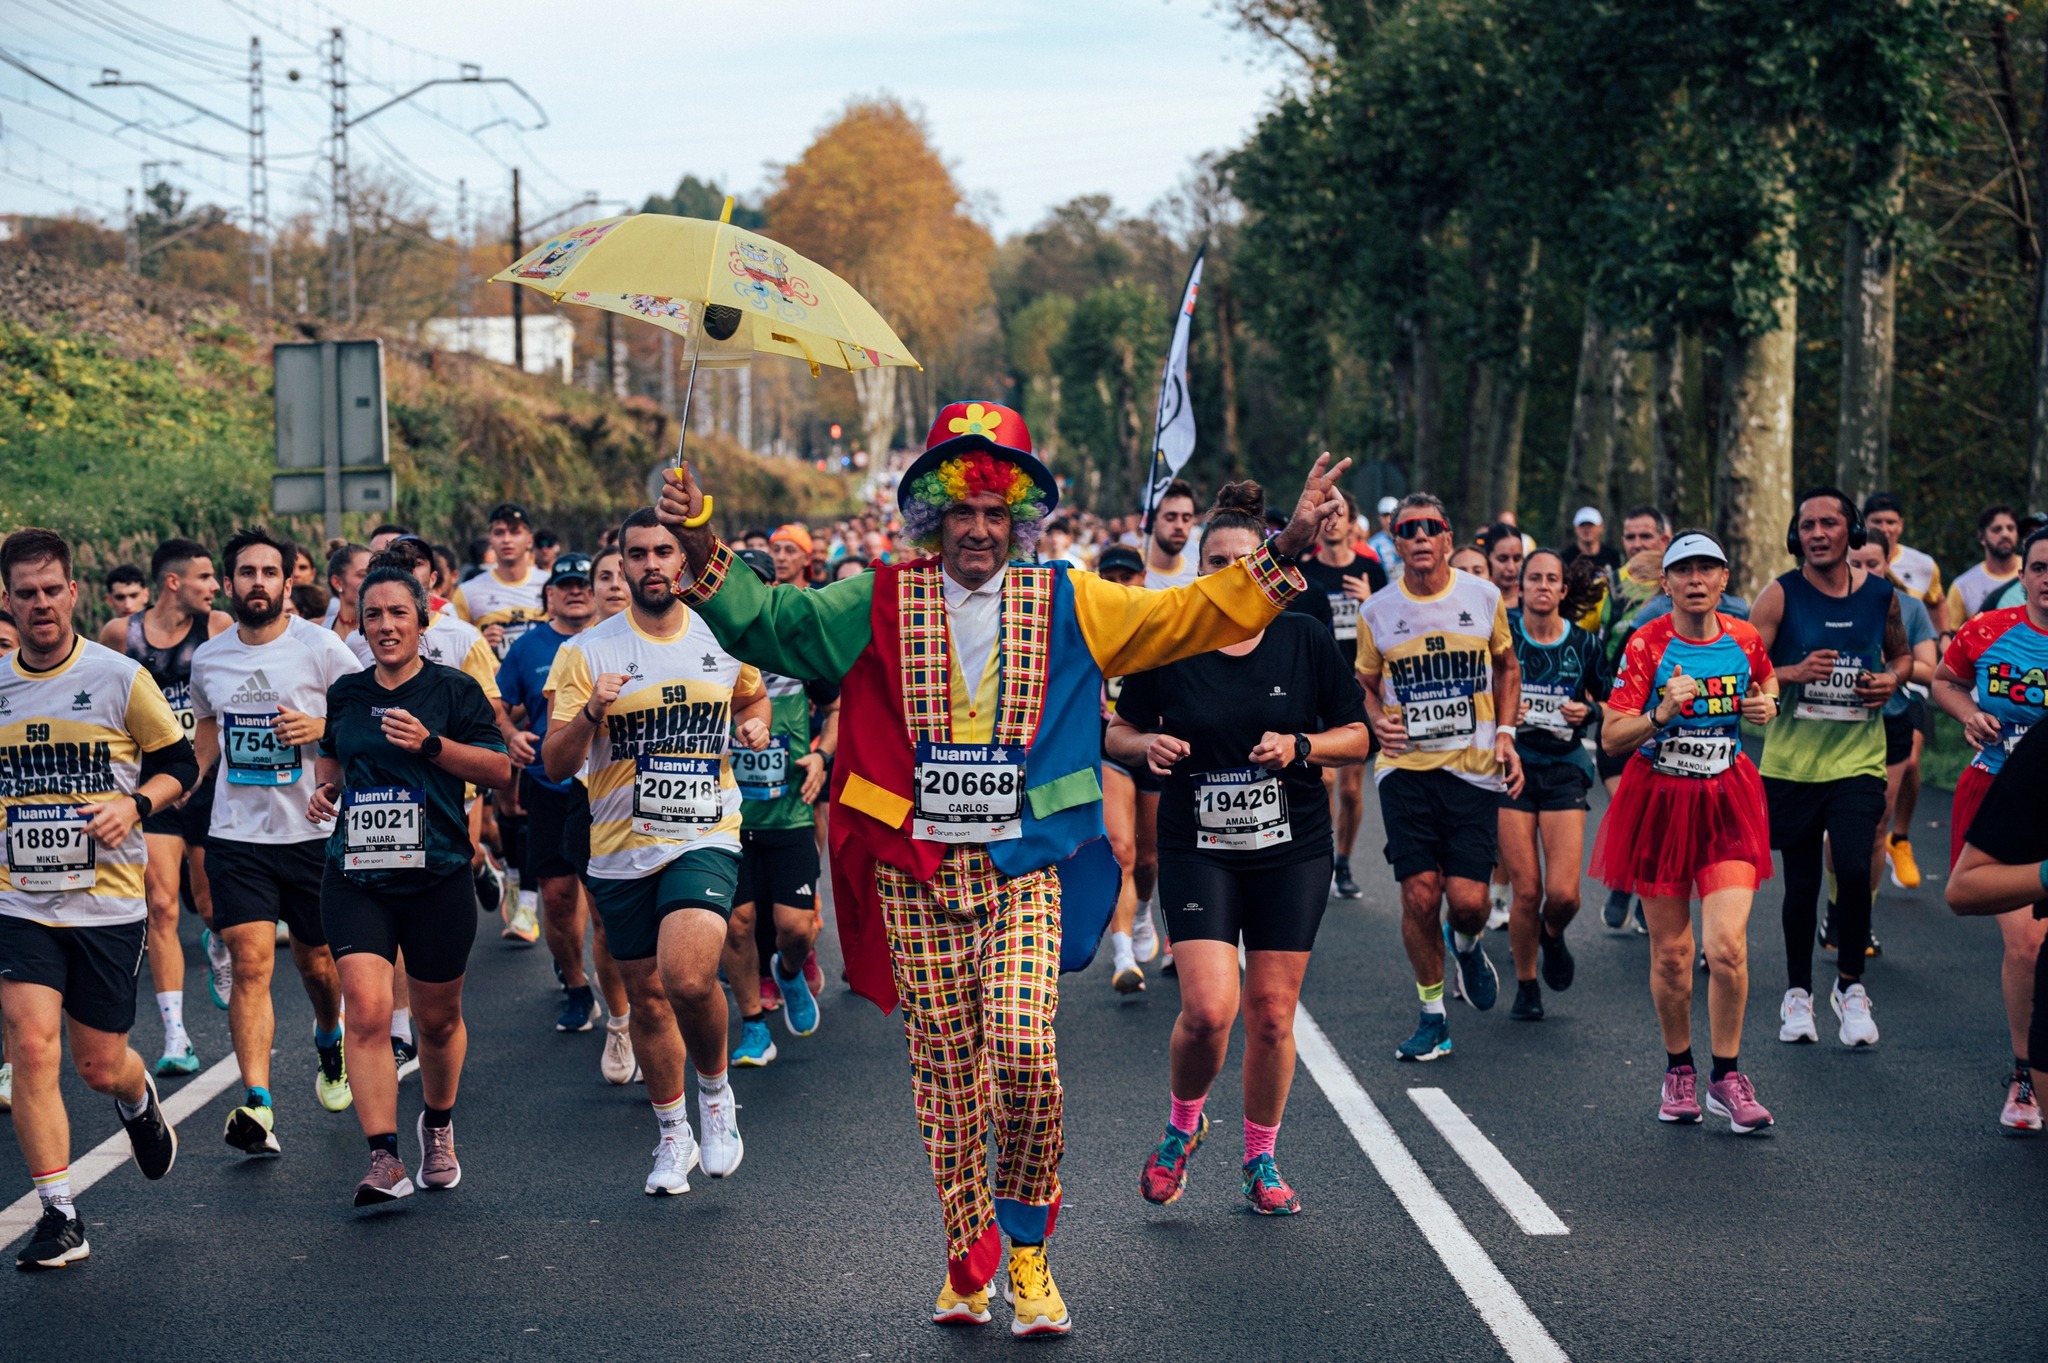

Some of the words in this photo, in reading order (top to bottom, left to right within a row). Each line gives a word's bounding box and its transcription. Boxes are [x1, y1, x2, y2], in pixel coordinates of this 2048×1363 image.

[1425, 636, 1446, 651] 59
[1389, 650, 1486, 686] BEHOBIA
[1989, 663, 2021, 679] #EL
[662, 685, 686, 704] 59
[1410, 688, 1447, 700] luanvi
[1521, 683, 1552, 694] uanvi
[231, 690, 279, 704] adidas
[1410, 701, 1468, 722] 21049
[235, 715, 270, 726] luanvi
[26, 723, 50, 742] 59
[1425, 724, 1456, 733] PHILIPPE
[931, 746, 988, 762] luanvi
[1665, 741, 1727, 760] 19871
[252, 756, 272, 764] JORDI
[649, 758, 696, 772] luanvi
[923, 770, 1014, 796] 20668
[1206, 770, 1252, 783] luanvi
[355, 788, 393, 803] luanvi
[643, 777, 713, 800] 20218
[1203, 785, 1277, 812] 19426
[17, 806, 61, 820] luanvi
[661, 805, 696, 815] PHARMA
[948, 803, 989, 813] CARLOS
[351, 809, 414, 830] 19021
[1225, 816, 1258, 826] AMALIA
[14, 827, 83, 849] 18897
[365, 835, 396, 844] NAIARA
[36, 855, 62, 864] MIKEL
